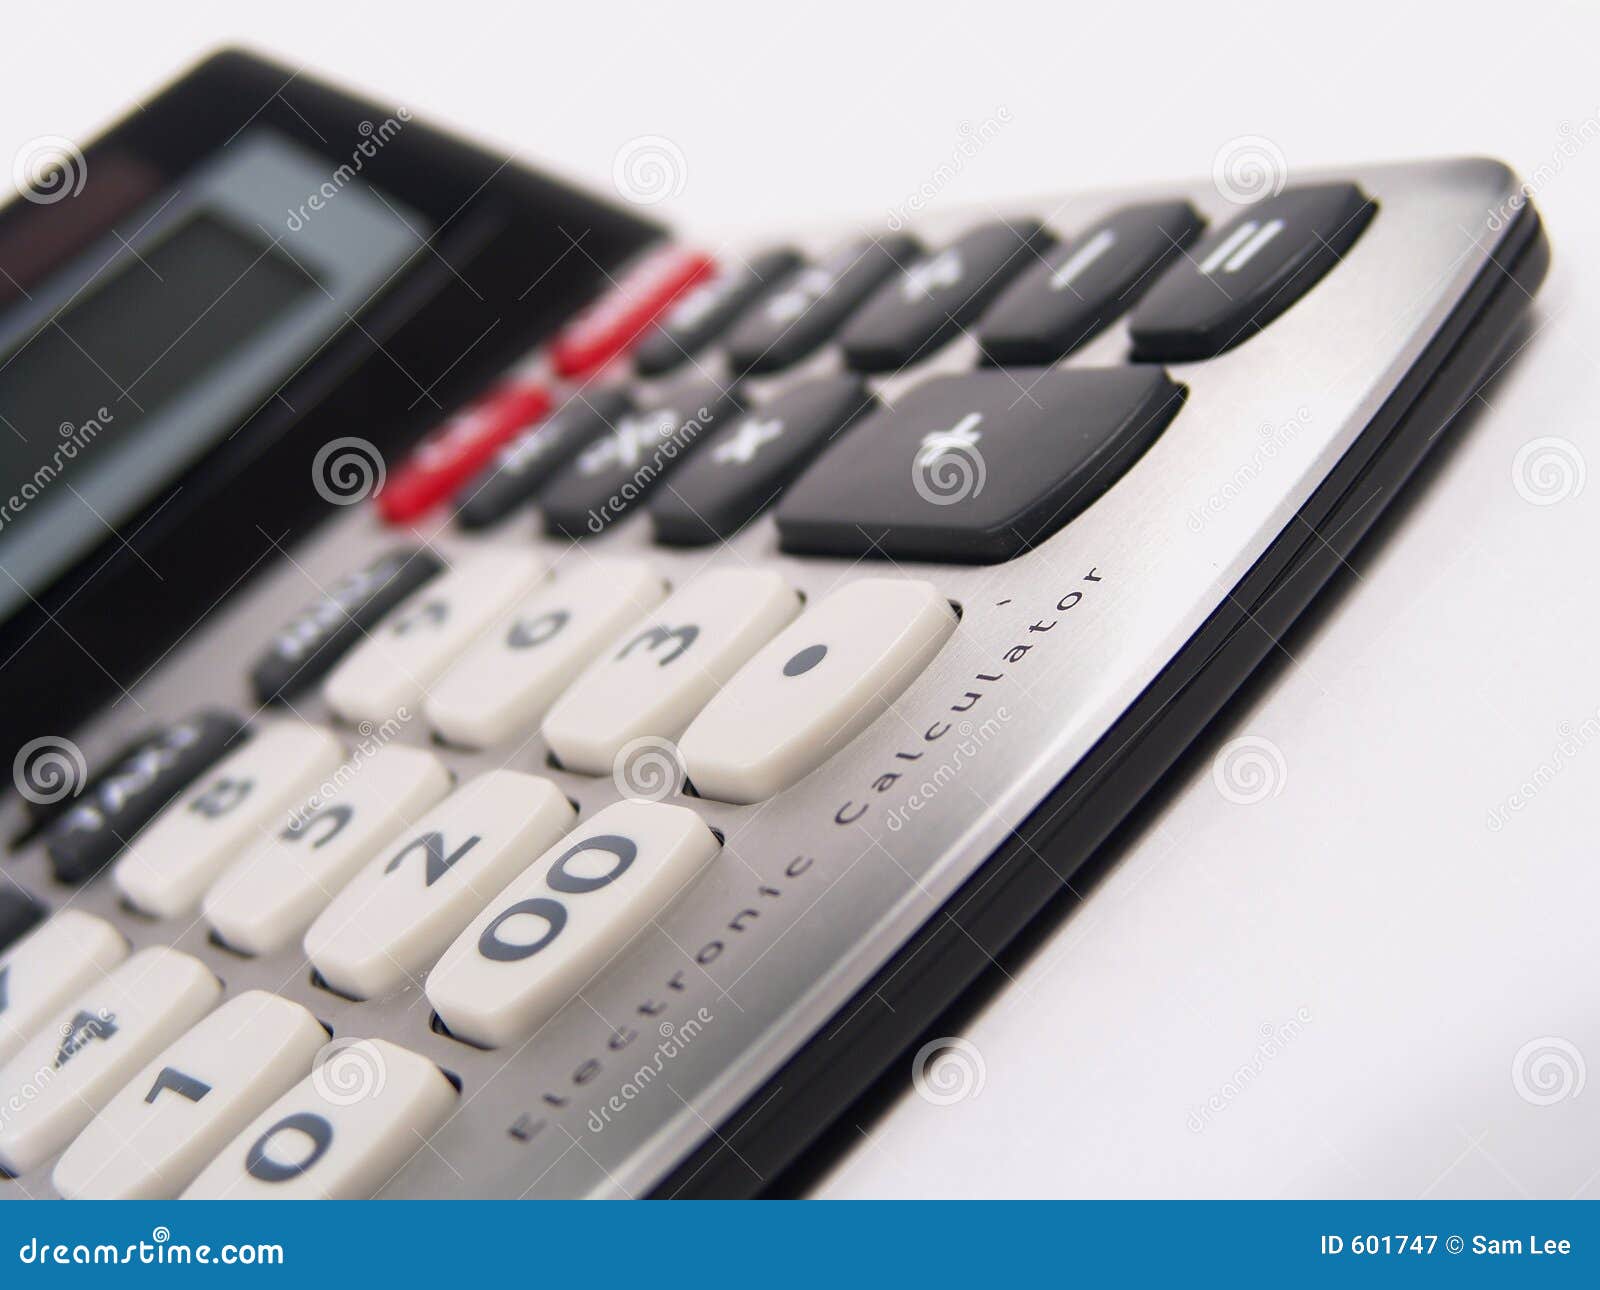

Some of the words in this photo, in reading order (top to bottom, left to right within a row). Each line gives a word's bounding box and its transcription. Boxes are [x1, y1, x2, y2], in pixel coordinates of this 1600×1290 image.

[505, 608, 571, 650] 6
[613, 622, 701, 668] 3
[279, 802, 354, 850] 5
[507, 854, 814, 1143] Electronic
[834, 567, 1103, 826] Calculator
[384, 830, 482, 888] 2
[477, 833, 639, 963] 00
[53, 1009, 120, 1070] 4
[143, 1066, 213, 1105] 1
[244, 1111, 334, 1183] 0
